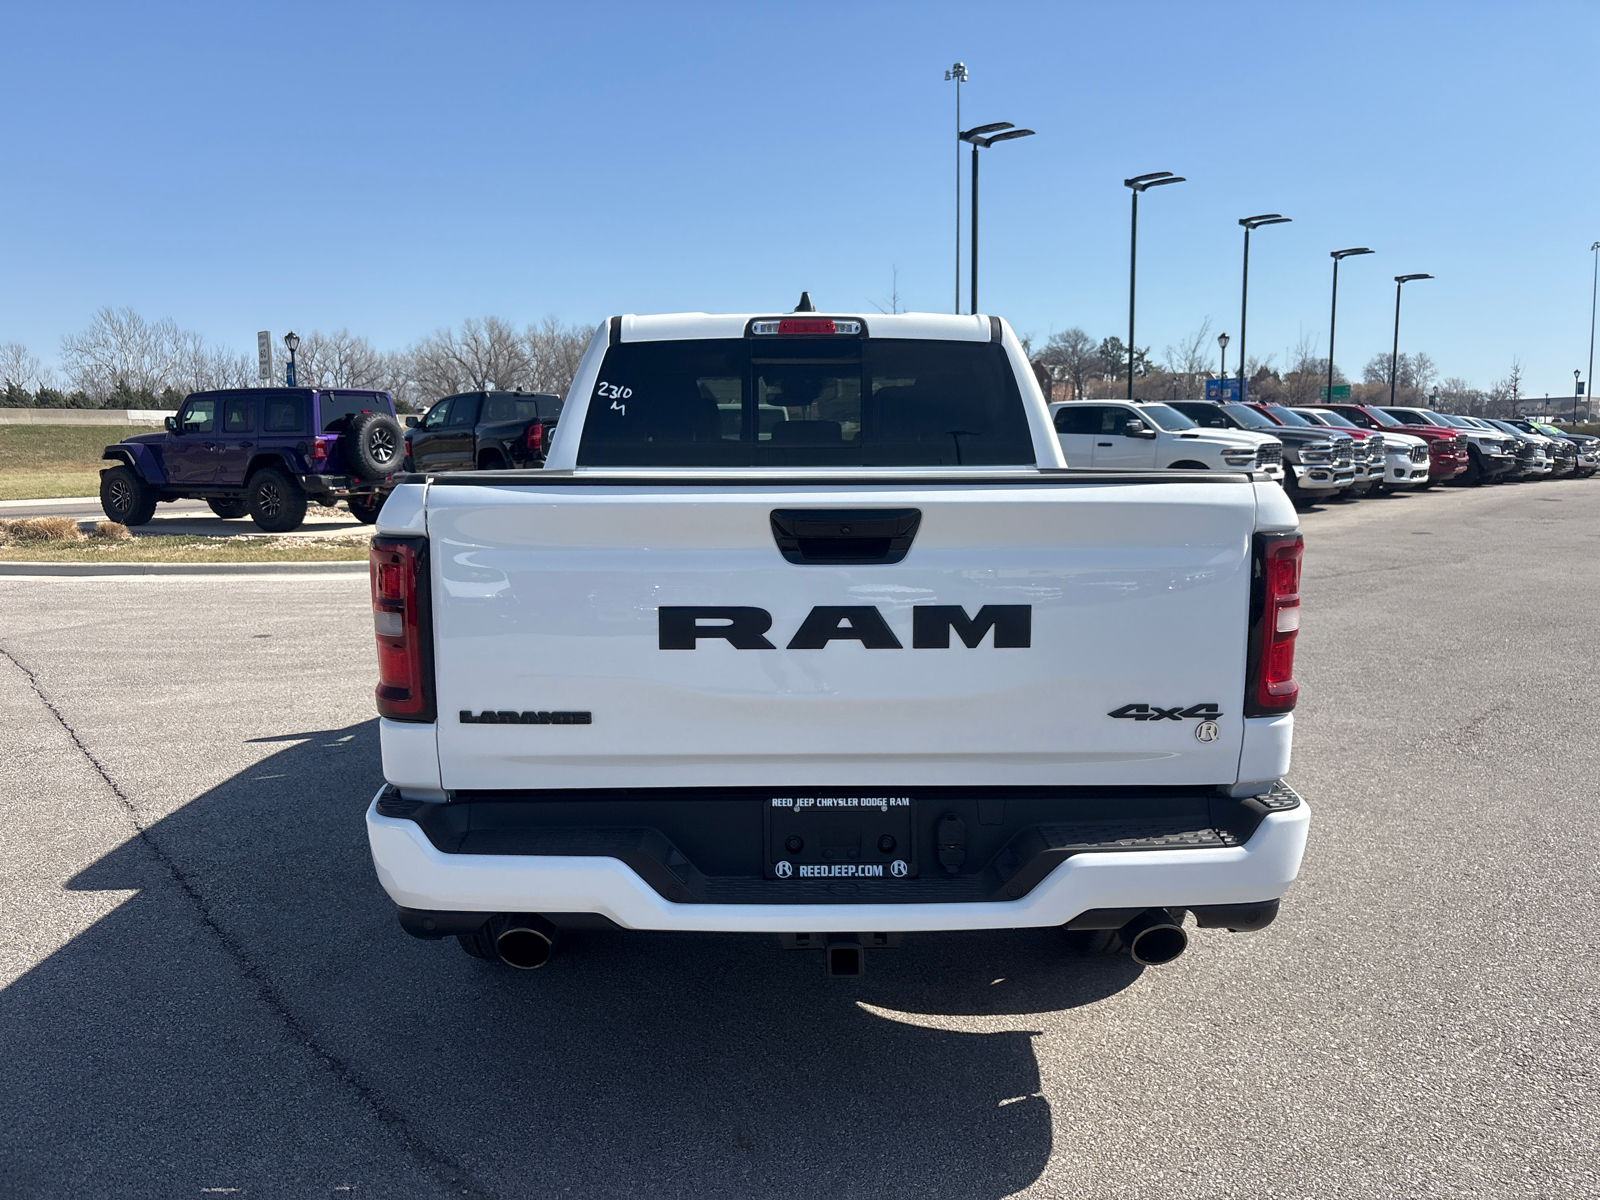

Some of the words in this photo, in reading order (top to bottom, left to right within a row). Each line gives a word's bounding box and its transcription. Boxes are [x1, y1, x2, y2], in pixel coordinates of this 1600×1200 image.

[597, 381, 633, 399] 2310
[658, 604, 1032, 650] RAM
[459, 710, 592, 724] LARAMIE
[1106, 703, 1224, 721] 4x4
[771, 798, 793, 807] REED
[795, 798, 814, 807] JEEP
[816, 798, 859, 807] CHRYSLER
[860, 797, 887, 806] DODGE
[889, 797, 910, 806] RAM
[799, 865, 883, 877] REEDJEEP.COM
